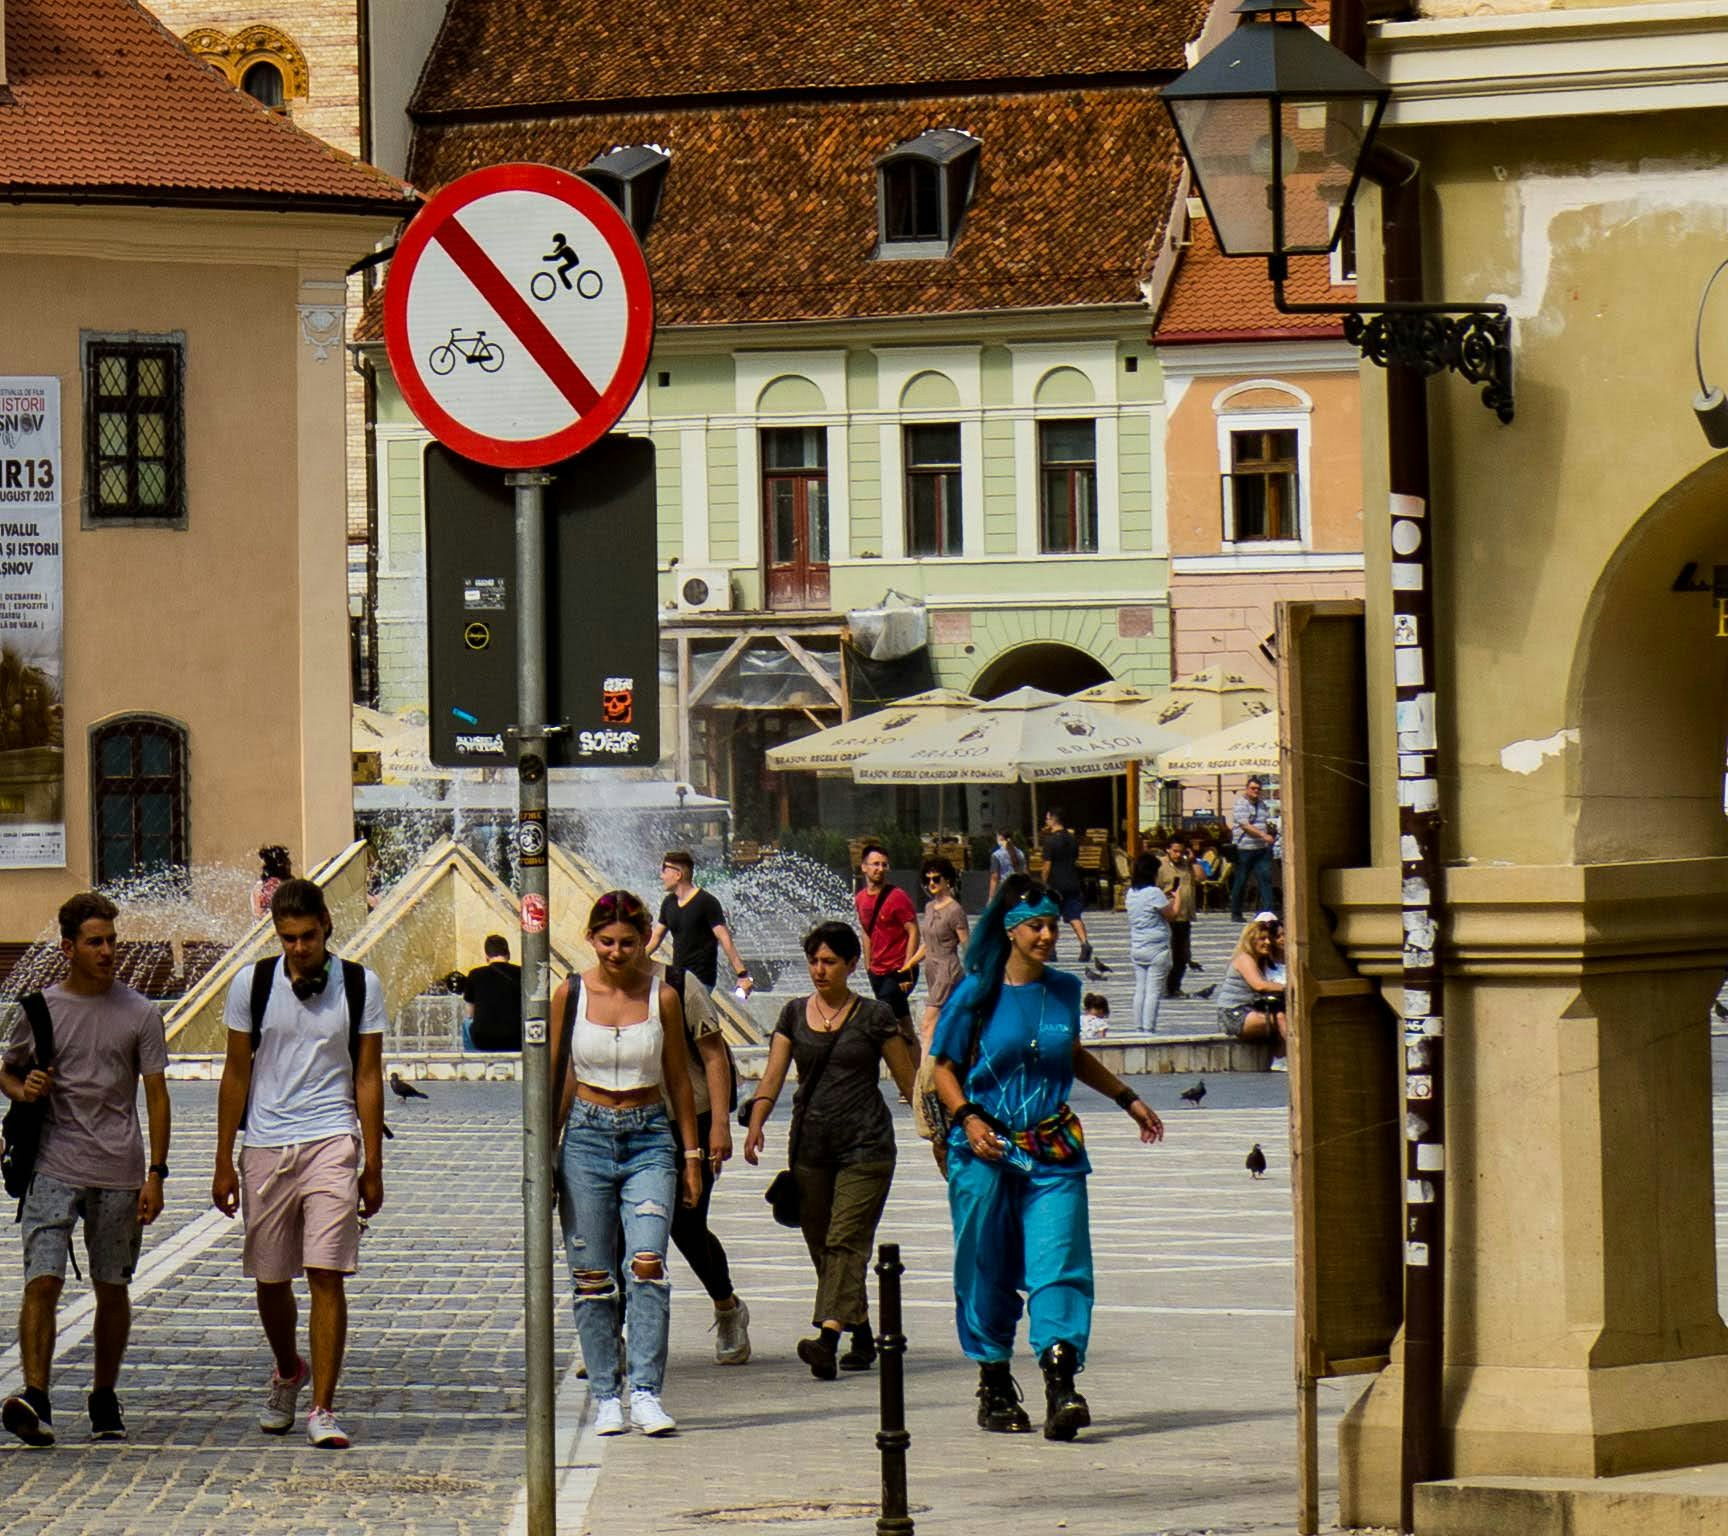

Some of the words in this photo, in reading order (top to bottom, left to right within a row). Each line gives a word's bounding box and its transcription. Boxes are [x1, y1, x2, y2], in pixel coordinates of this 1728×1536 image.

[2, 397, 45, 412] ISTORII
[33, 490, 55, 502] 2021
[6, 542, 16, 559] ȘI
[18, 542, 59, 556] ISTORII
